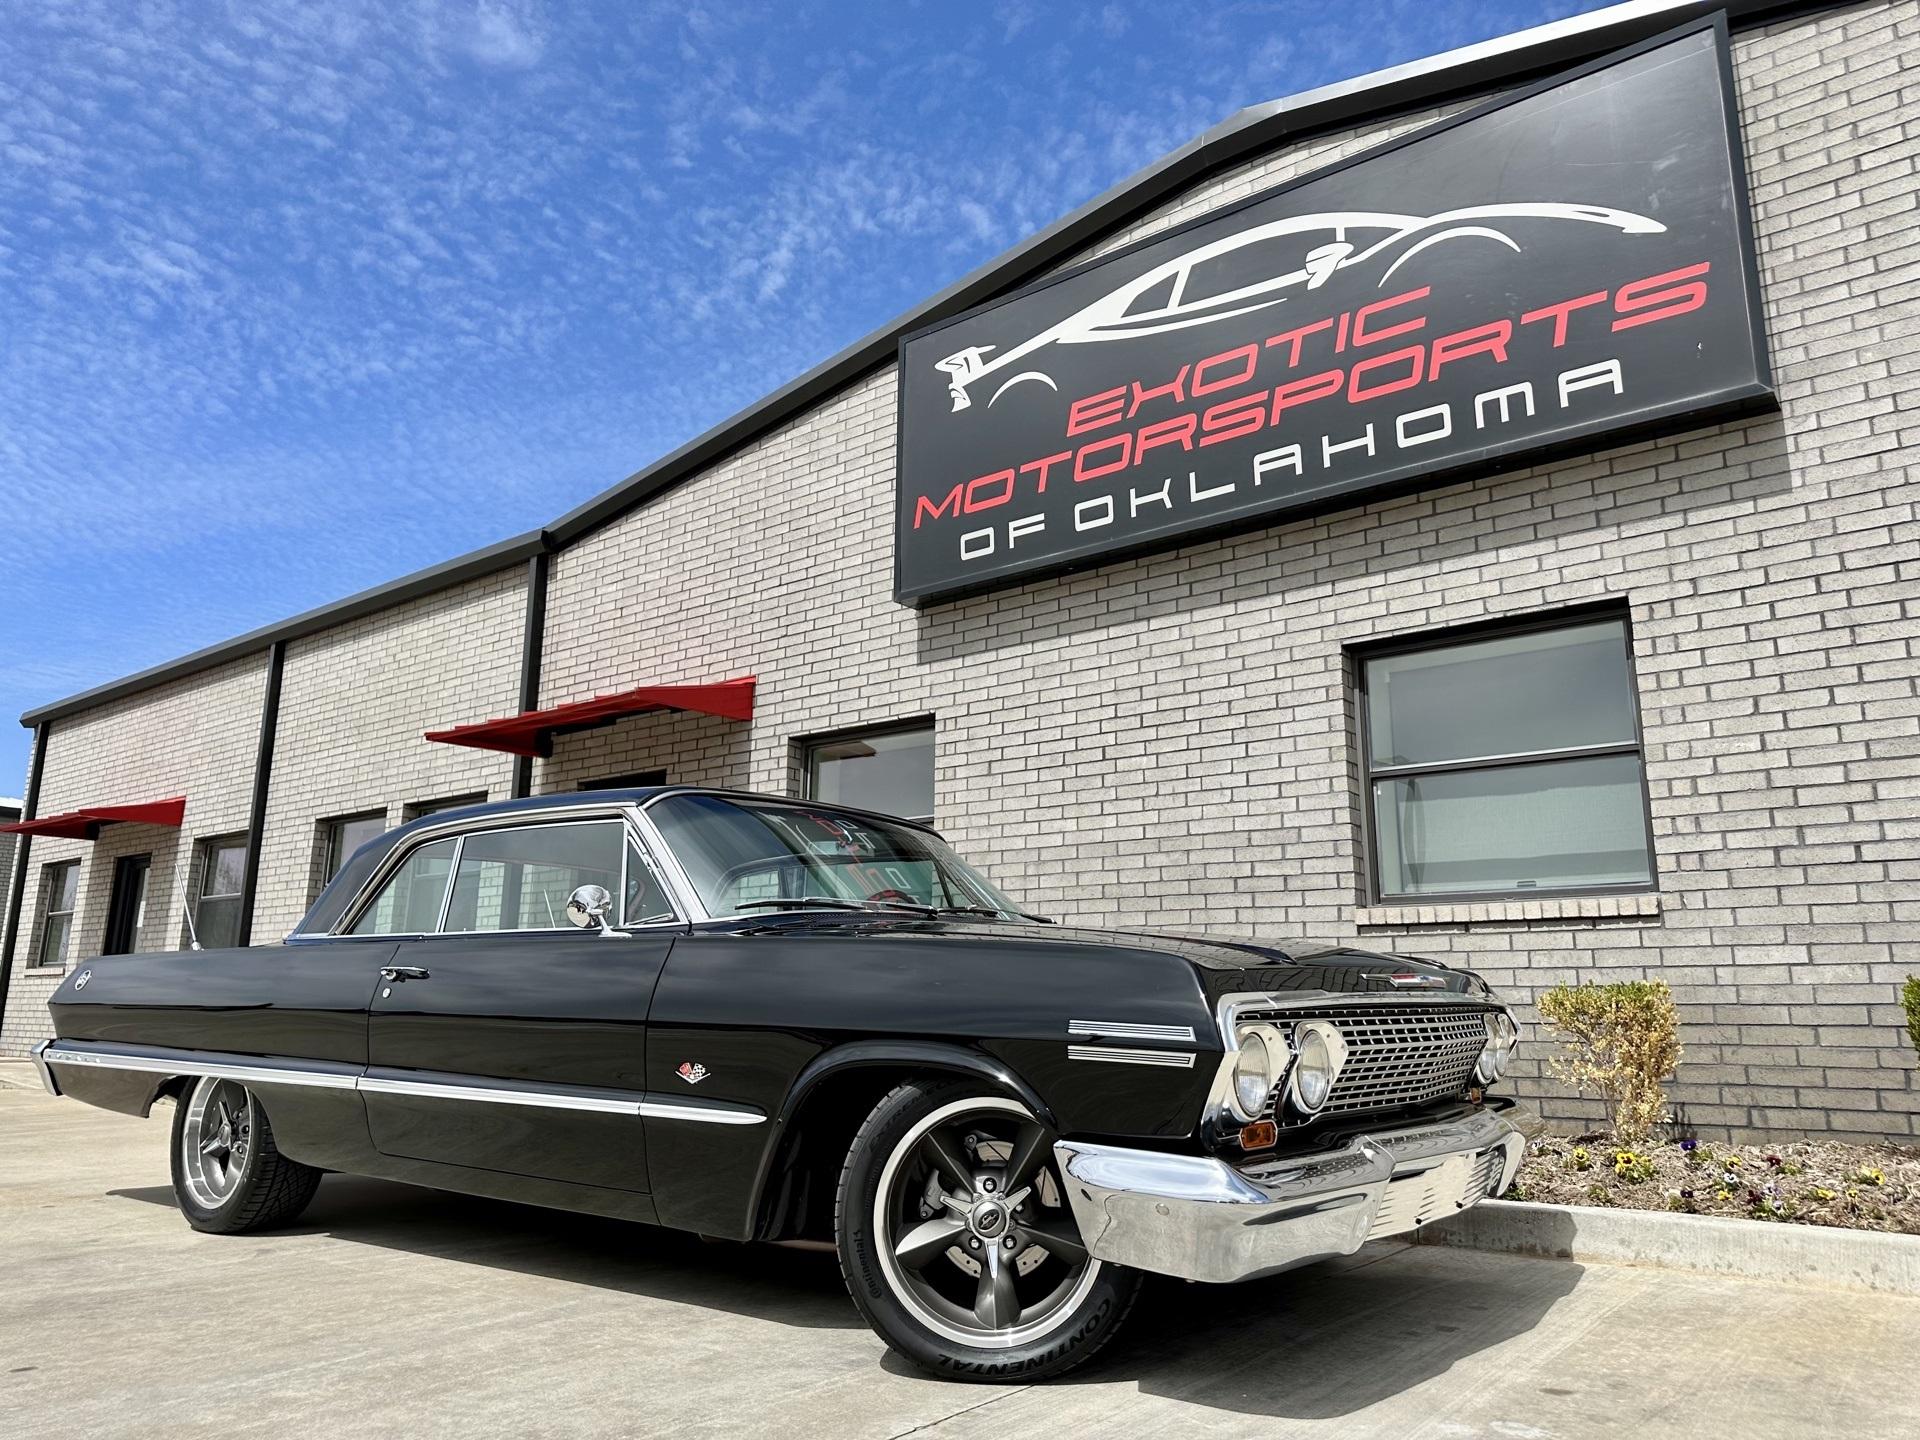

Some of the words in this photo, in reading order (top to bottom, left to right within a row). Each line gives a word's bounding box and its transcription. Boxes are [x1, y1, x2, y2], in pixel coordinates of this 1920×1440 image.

[914, 262, 1711, 529] MOTORSPORTS
[1068, 288, 1430, 437] EXOTIC
[960, 513, 1046, 561] OF
[1074, 359, 1624, 532] OKLAHOMA
[939, 1297, 1113, 1376] CONTINENTAL
